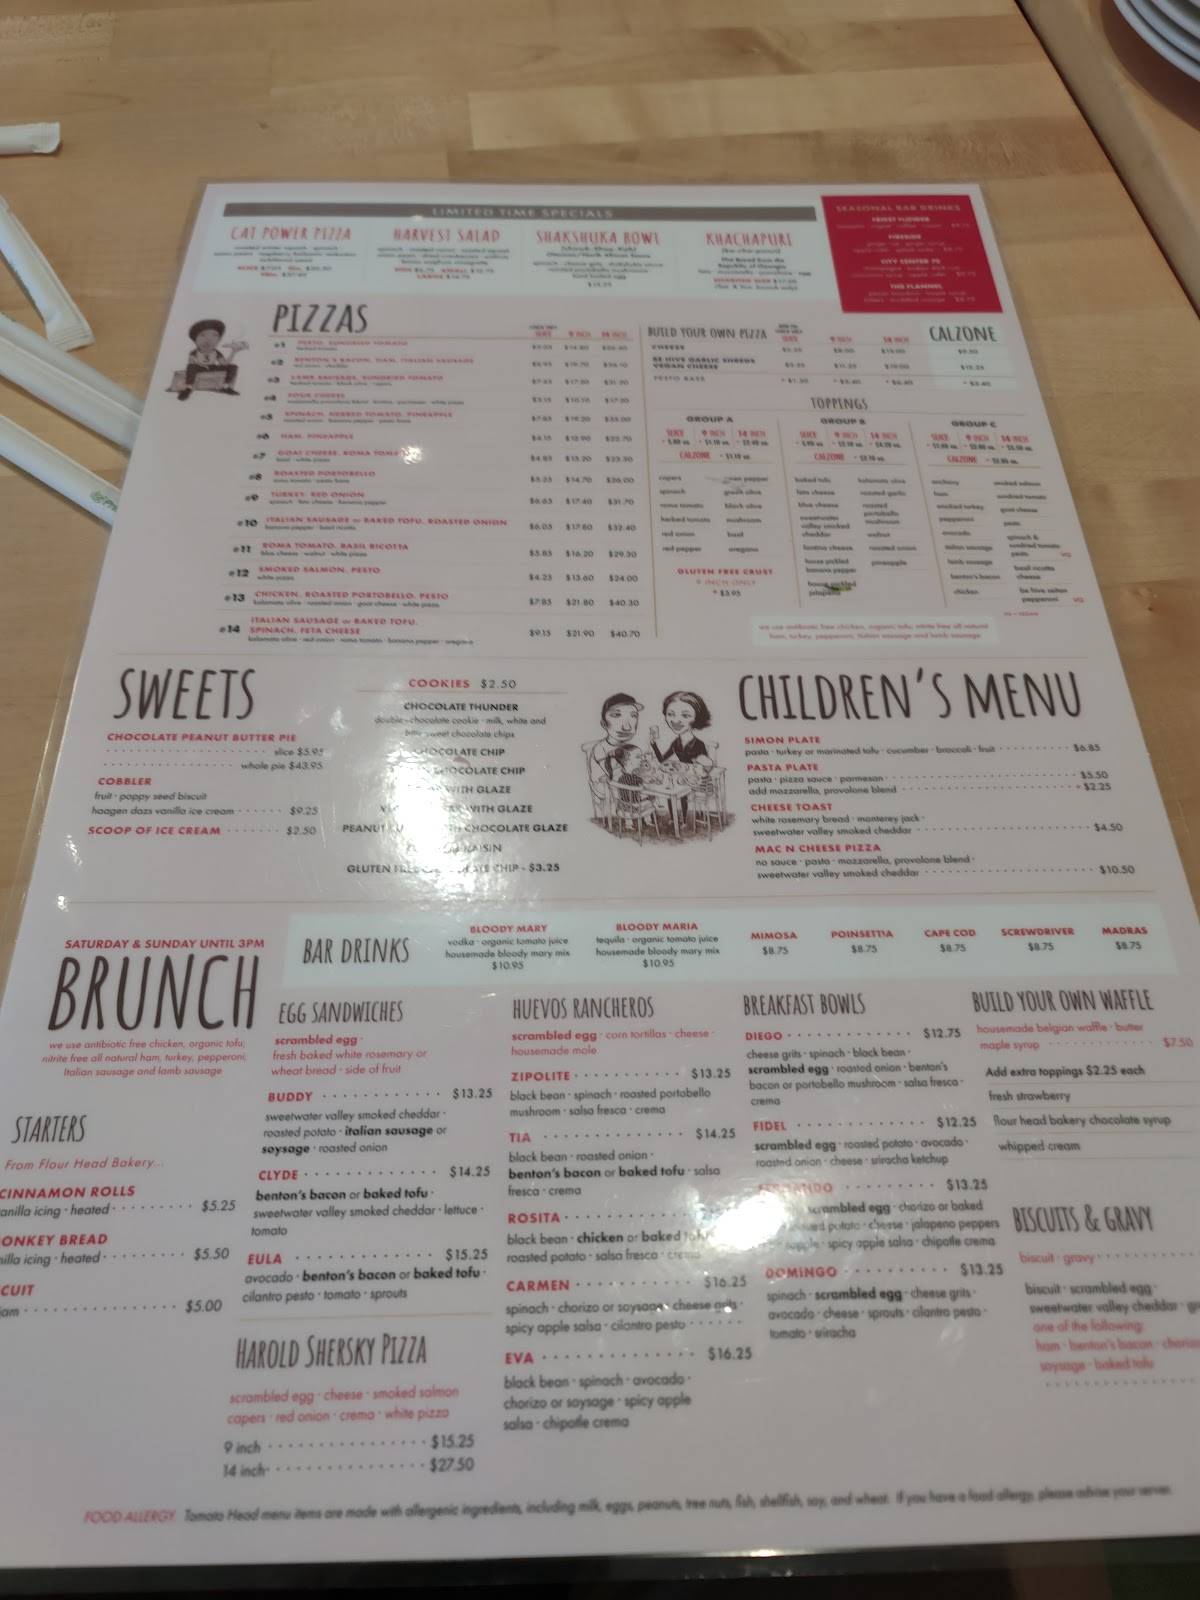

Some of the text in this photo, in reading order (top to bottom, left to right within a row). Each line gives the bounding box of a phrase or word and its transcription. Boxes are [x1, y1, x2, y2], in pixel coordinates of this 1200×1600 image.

[431, 206, 614, 220] LIMITED TIME SPECIALS
[231, 227, 352, 241] CAT POWER PIZZA
[393, 229, 500, 242] HARVEST SALAD
[536, 230, 660, 245] SHAKSHUKA BOWL
[704, 232, 792, 247] KHACHAPURI
[272, 304, 367, 333] PIZZAS
[647, 325, 678, 338] BUILD
[679, 326, 707, 339] YOUR
[709, 327, 736, 340] OWN
[738, 327, 768, 340] PIZZA
[929, 326, 997, 342] CALZONE
[811, 397, 868, 410] TOPPINGS
[685, 415, 724, 424] GROUP
[819, 417, 858, 425] GROUP
[950, 419, 989, 428] GROUP
[272, 469, 377, 478] ROASTED PORTOBELLO
[676, 567, 773, 576] GLUTEN FREE CRUST
[407, 678, 518, 690] COOKIES $2.50
[113, 668, 255, 720] SWEETS
[739, 667, 1081, 721] CHILDREN'S MENU
[403, 701, 519, 713] CHOCOLATE THUNDER
[106, 732, 297, 743] CHOCOLATE PEANUT BUTTER PIE
[744, 735, 821, 745] SIMON PLATE
[1072, 743, 1101, 753] $6.85
[746, 762, 819, 773] PASTA PLATE
[97, 776, 153, 786] COBBLER
[750, 802, 833, 813] CHEESE TOAST
[87, 824, 222, 836] SCOOP OF ICE CREAM
[754, 843, 882, 854] MAC N CHEESE PIZZA
[1097, 864, 1136, 876] $10.50
[469, 924, 548, 935] BLOODY MARY
[615, 922, 699, 932] BLOODY MARIA
[923, 928, 977, 939] CAPE COD
[1000, 926, 1076, 937] SCREWDRIVER
[1101, 926, 1149, 936] MADRAS
[750, 930, 799, 941] MIMOSA
[830, 929, 895, 939] POINSETTIA
[64, 938, 265, 950] SATURDAY & SUNDAY UNTIL 3PM
[303, 937, 409, 964] BAR DRINKS
[939, 943, 967, 954] $8.75
[1114, 940, 1143, 951] $8.75
[761, 945, 790, 957] $8.75
[491, 960, 525, 971] $10.95
[48, 954, 259, 1031] BRUNCH
[743, 993, 866, 1016] BREAKFAST BOWLS
[971, 989, 1154, 1013] BUILD YOUR OWN WAFFLE
[279, 1000, 403, 1024] EGG SANDWICHES
[513, 996, 654, 1020] HUEVOS RANCHEROS
[274, 1033, 359, 1048] scrambled egg
[744, 1027, 961, 1042] DIEGO $12.75
[510, 1070, 572, 1083] ZIPOLITE
[984, 1063, 1147, 1079] Add extra toppings $2.25 each
[267, 1088, 493, 1103] BUDDY $13.25
[264, 1108, 439, 1123] sweetwater valley smoked cheddar
[11, 1115, 87, 1144] STARTERS
[752, 1120, 788, 1132] FIDEL
[509, 1132, 531, 1144] TIA
[998, 1140, 1082, 1154] whipped cream
[3, 1156, 163, 1172] From Flour Head Bakery...
[257, 1166, 490, 1182] CLYDE $14.25
[0, 1185, 135, 1200] CINNAMON ROLLS
[255, 1186, 428, 1202] benton's bacon or baked tofu
[201, 1200, 236, 1213] $5.25
[508, 1212, 561, 1224] ROSITA
[1012, 1204, 1153, 1233] BISCUITS & GRAVY
[59, 1233, 108, 1246] BREAD
[194, 1247, 229, 1261] $5.50
[247, 1248, 488, 1265] EULA $15.25
[765, 1266, 837, 1279] DOMINGO
[506, 1280, 569, 1292] CARMEN
[235, 1333, 427, 1370] HAROLD SHERSKY PIZZA
[505, 1346, 752, 1365] EVA $16.25
[223, 1434, 474, 1454] 9 inch $15.25
[223, 1456, 475, 1478] 14 inch $27.50
[83, 1509, 176, 1525] FOOD ALLERGY
